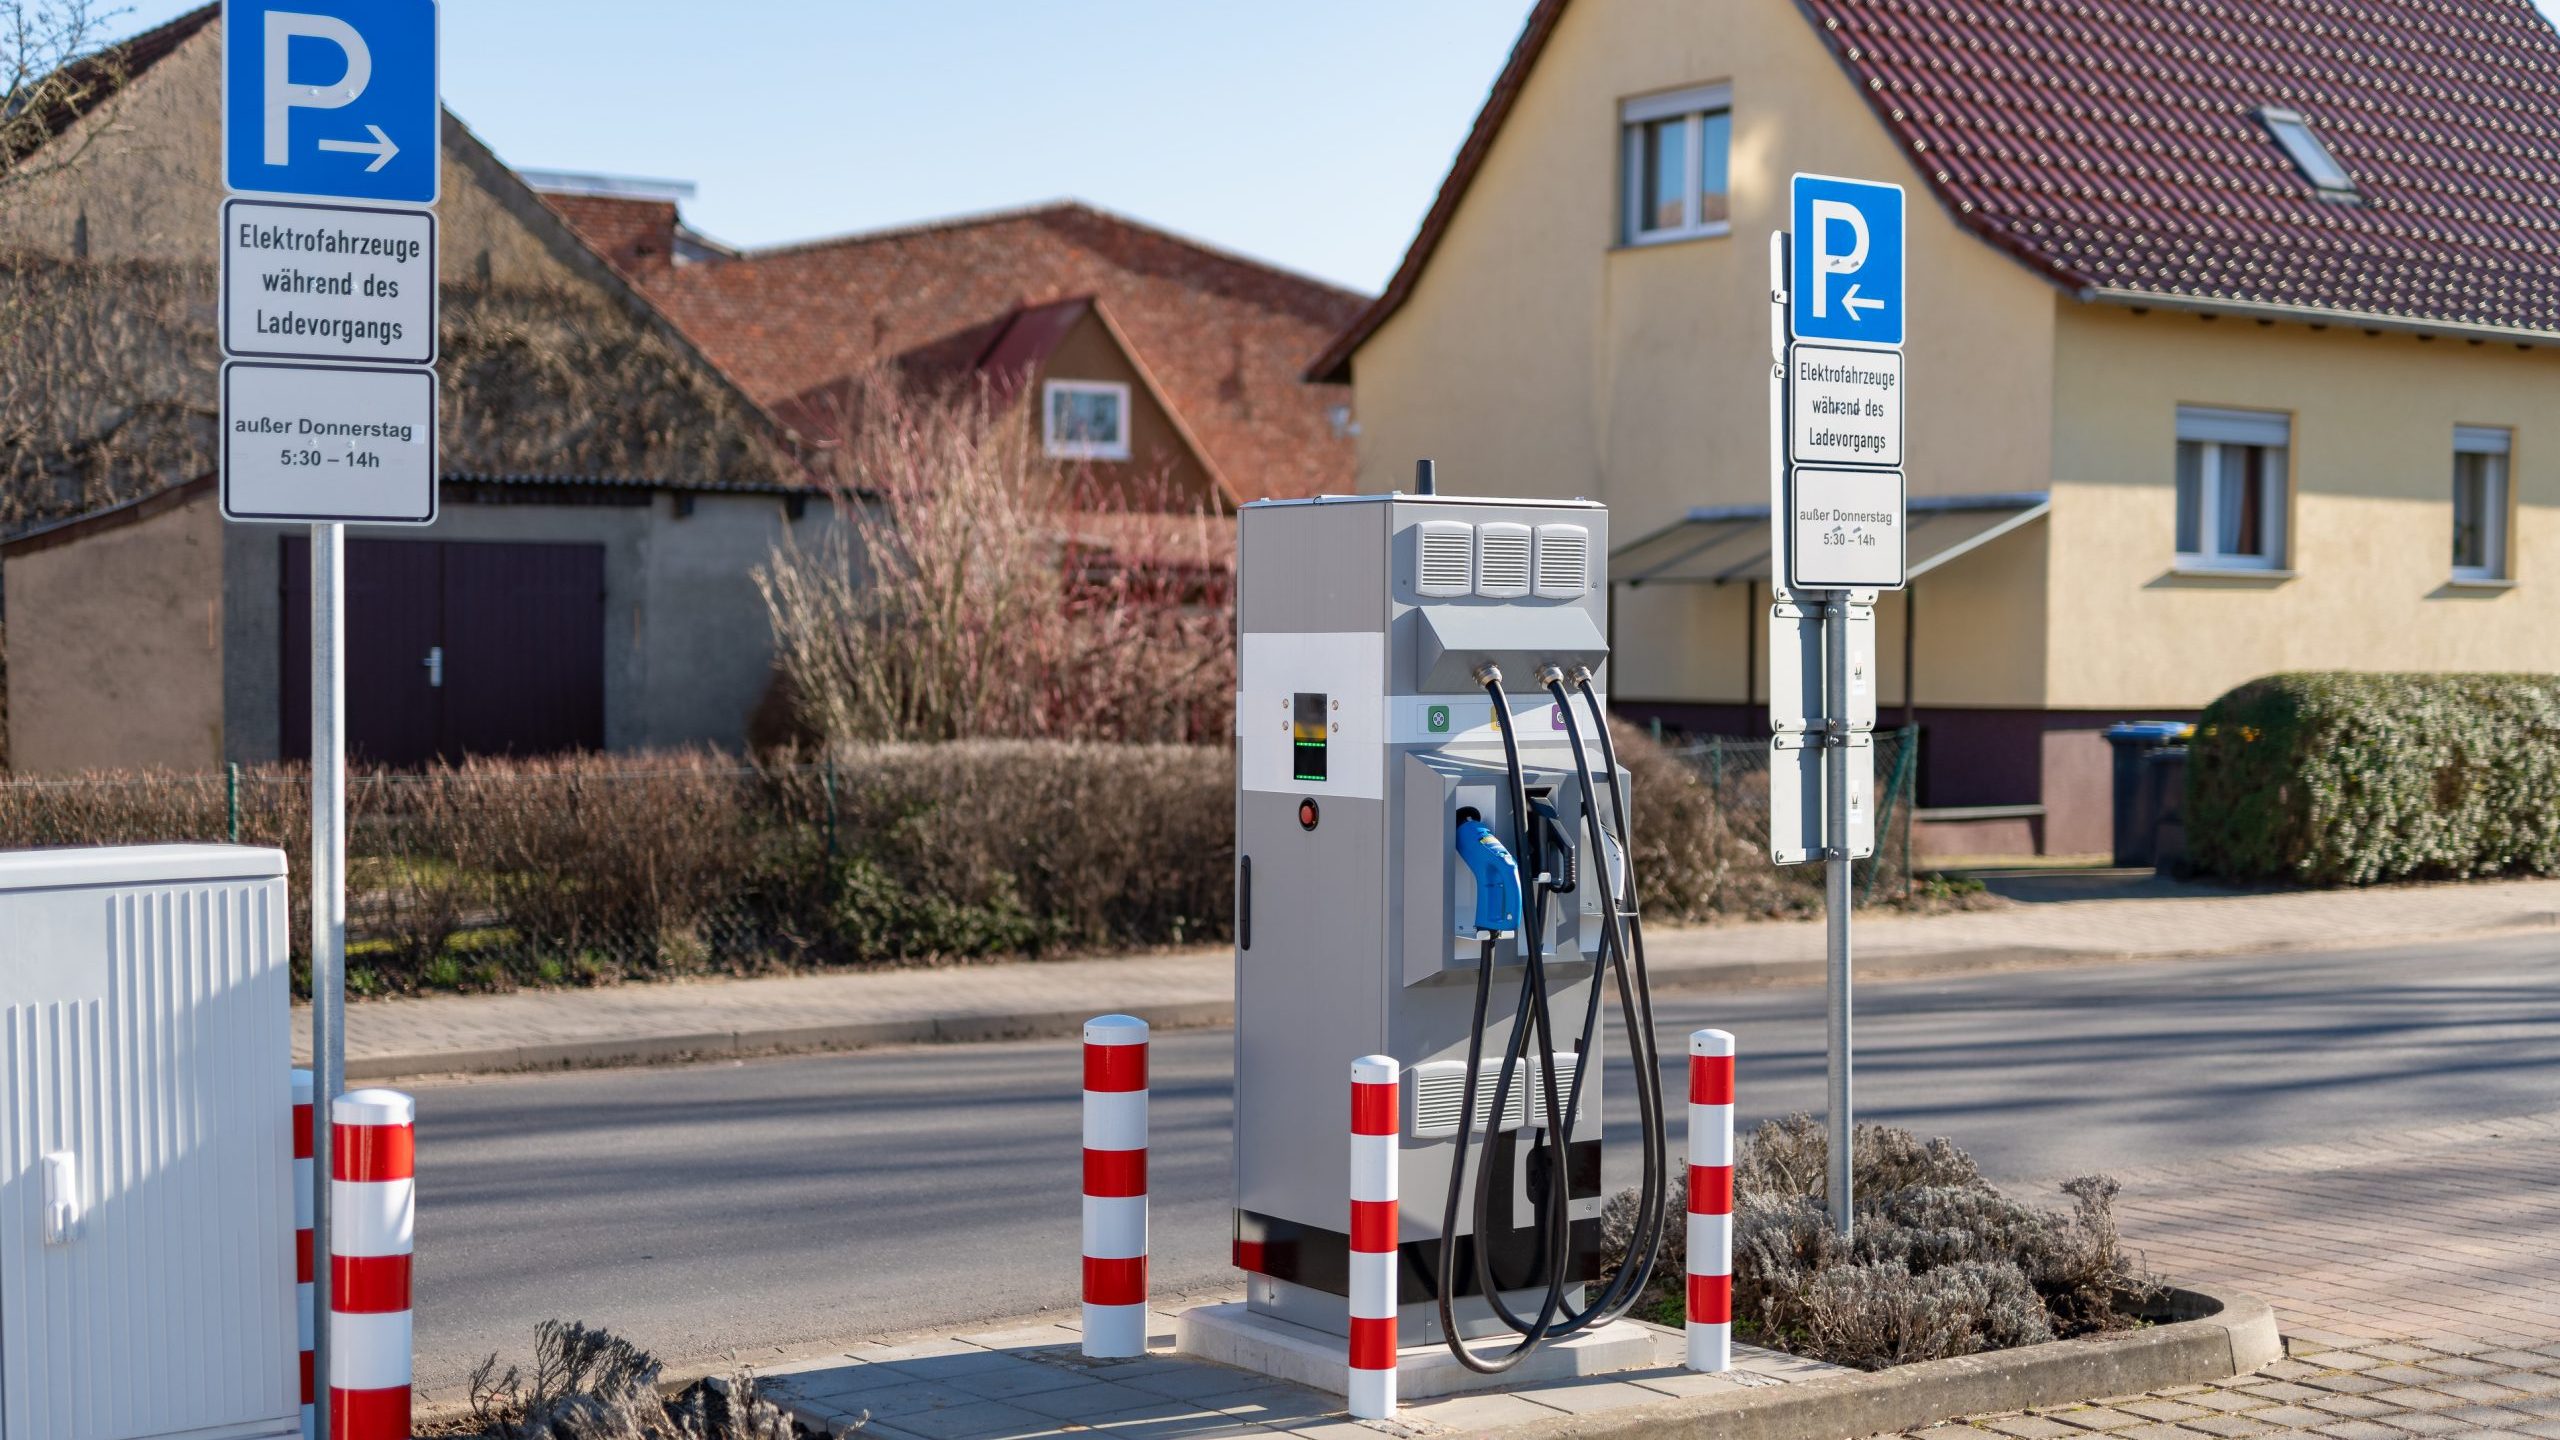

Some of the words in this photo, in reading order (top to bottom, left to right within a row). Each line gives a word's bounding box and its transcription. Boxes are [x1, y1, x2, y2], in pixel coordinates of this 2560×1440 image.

[240, 223, 420, 263] Elektrofahrzeuge
[262, 268, 352, 296] während
[363, 273, 399, 298] des
[256, 309, 403, 345] Ladevorgangs
[1800, 362, 1895, 391] Elektrofahrzeuge
[1813, 396, 1860, 416] während
[1865, 399, 1884, 417] des
[235, 417, 293, 434] außer
[298, 419, 412, 442] Donnerstag
[1809, 427, 1886, 453] Ladevorgangs
[280, 450, 322, 467] 5:30
[345, 451, 380, 468] 14h
[1800, 508, 1830, 521] außer
[1833, 509, 1892, 526] Donnerstag
[1823, 533, 1845, 545] 5:30
[1857, 534, 1876, 546] 14h
